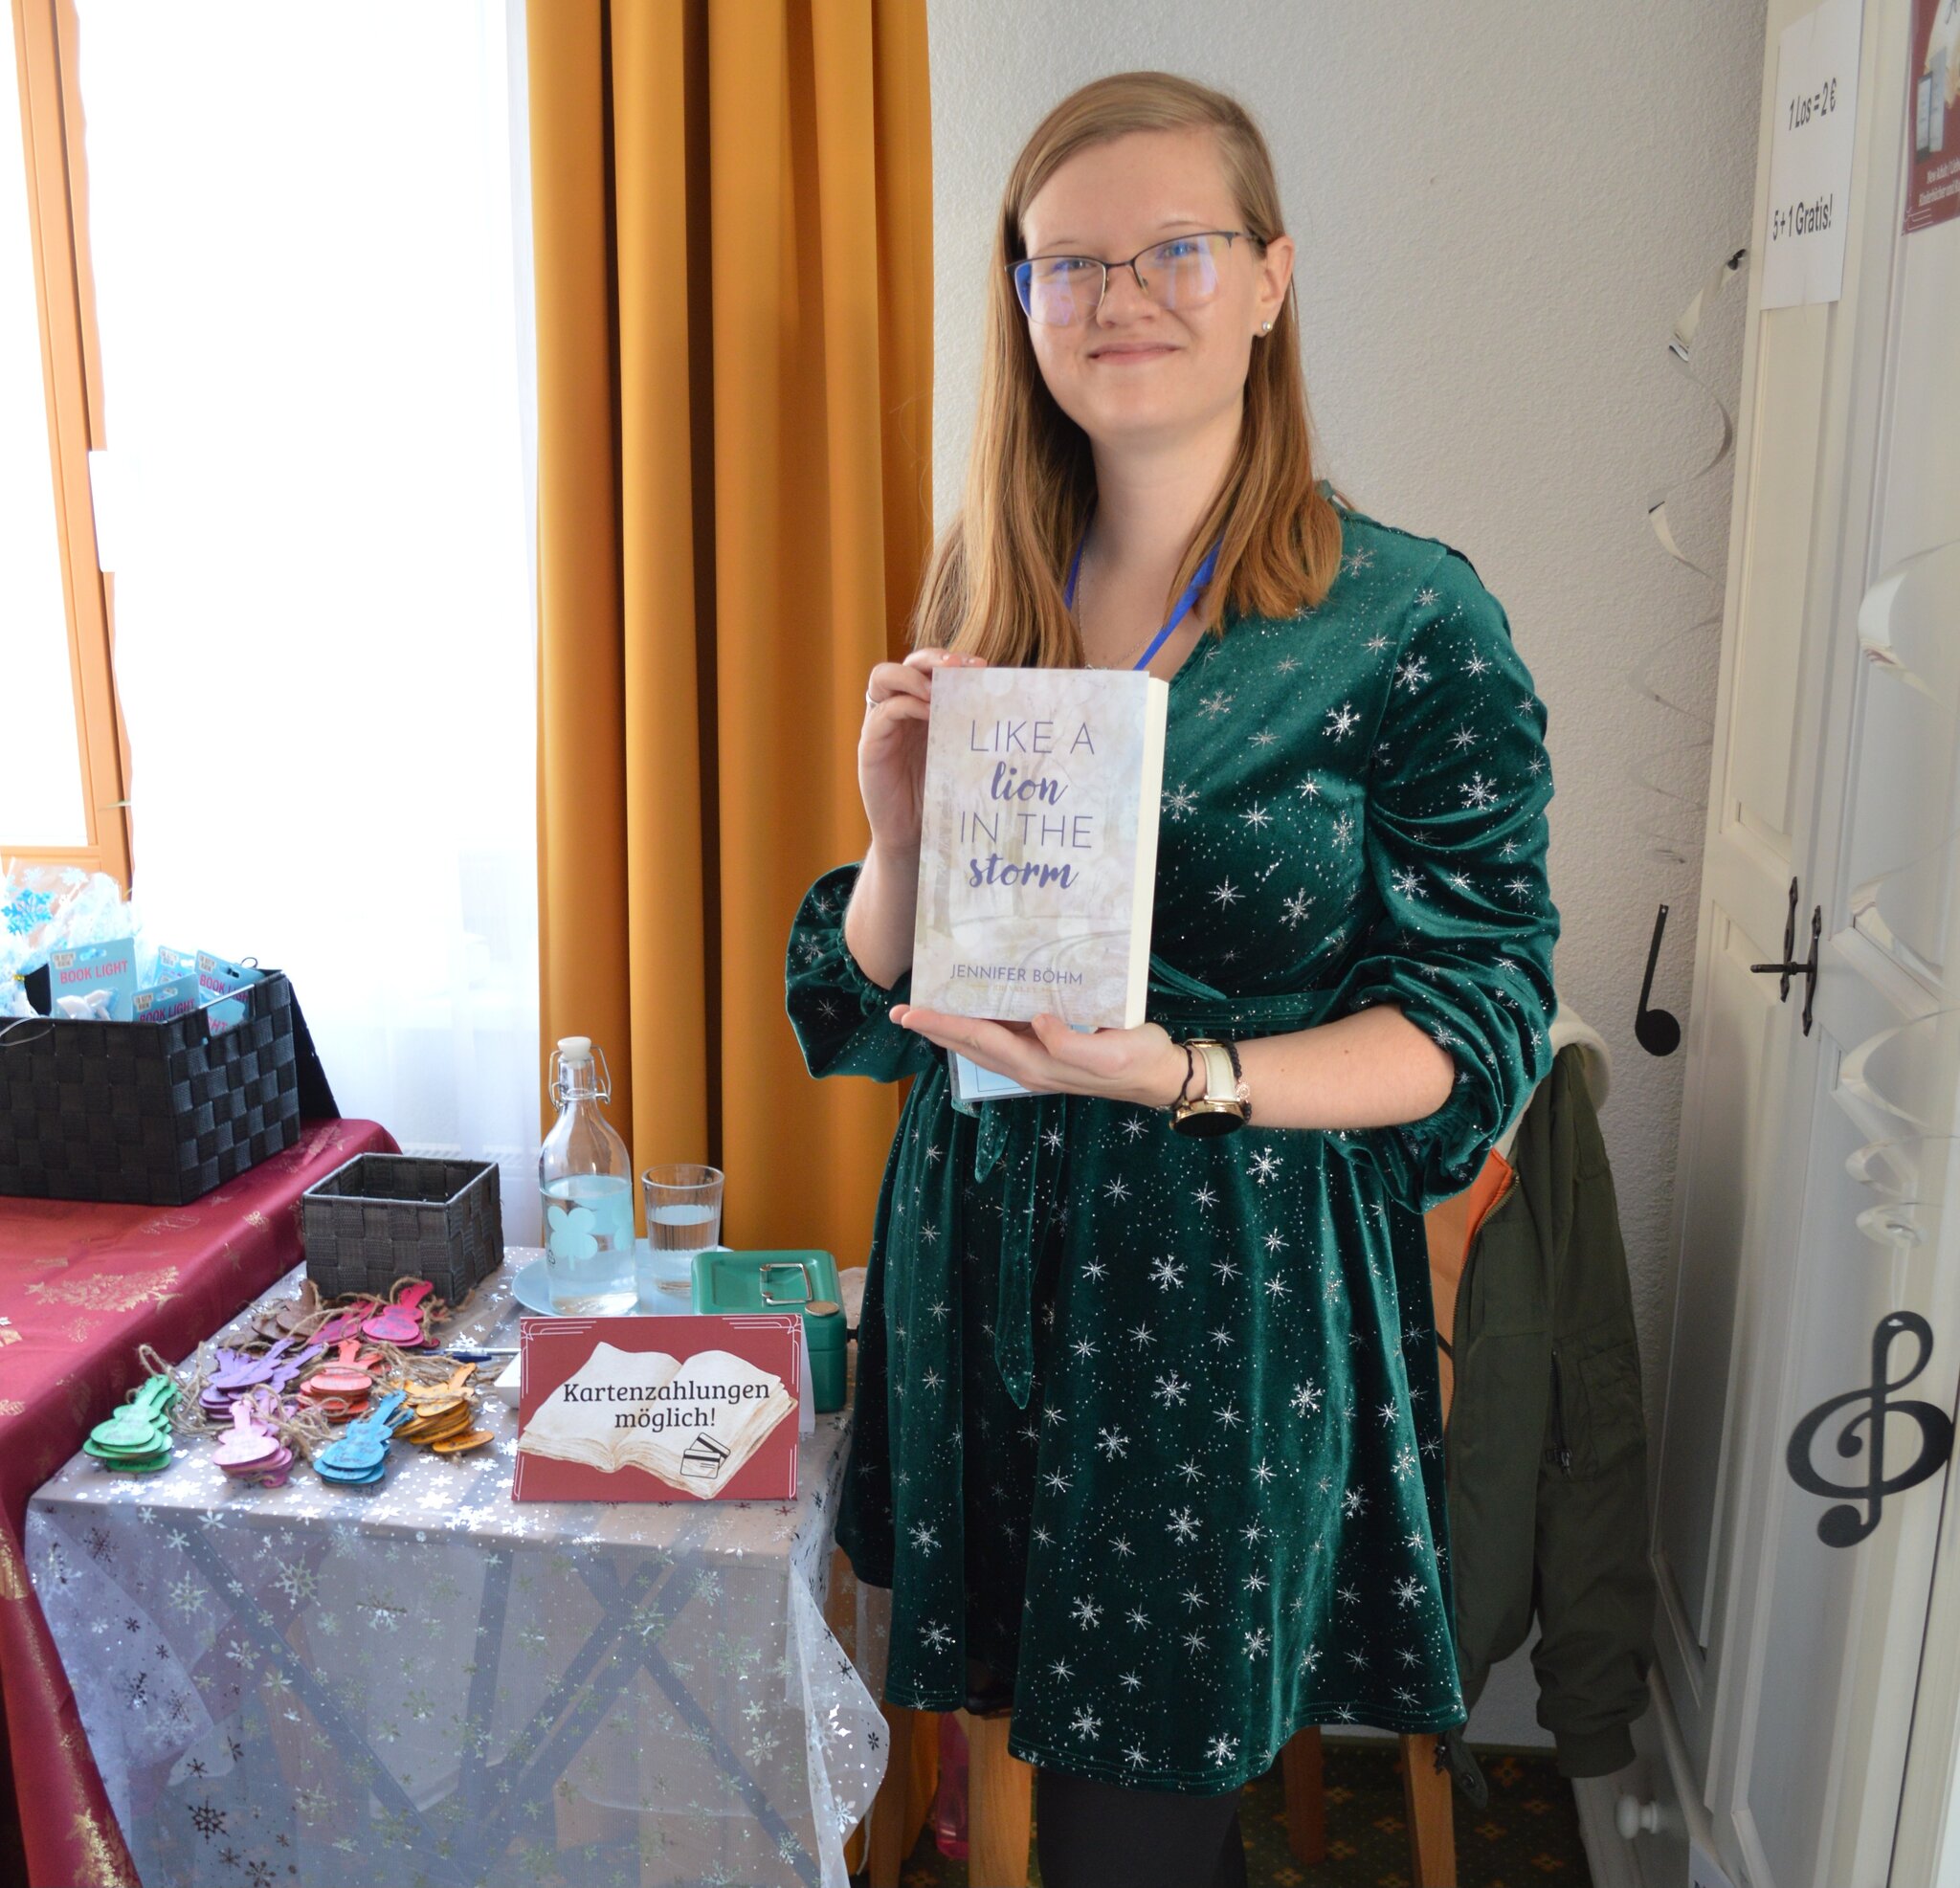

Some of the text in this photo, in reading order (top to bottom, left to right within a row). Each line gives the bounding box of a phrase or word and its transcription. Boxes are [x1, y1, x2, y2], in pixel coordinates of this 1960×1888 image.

[1789, 99, 1794, 131] 1
[1794, 95, 1812, 128] Los
[1820, 81, 1829, 117] 2
[1830, 77, 1838, 113] €
[1772, 210, 1779, 241] 5
[1789, 205, 1793, 238] 1
[1795, 192, 1834, 236] Gratis!
[970, 719, 1095, 755] LIKE A
[991, 760, 1069, 806] lion
[960, 811, 1094, 850] IN THE
[969, 853, 1080, 890] storm
[59, 966, 93, 985] BOOK
[94, 958, 128, 979] LIGHT
[199, 973, 226, 996] BOOK
[949, 964, 1083, 985] JENNIFER BÖHM
[167, 997, 195, 1017] LIGHT
[564, 1380, 770, 1405] Kartenzahlungen
[614, 1407, 716, 1433] möglich!
